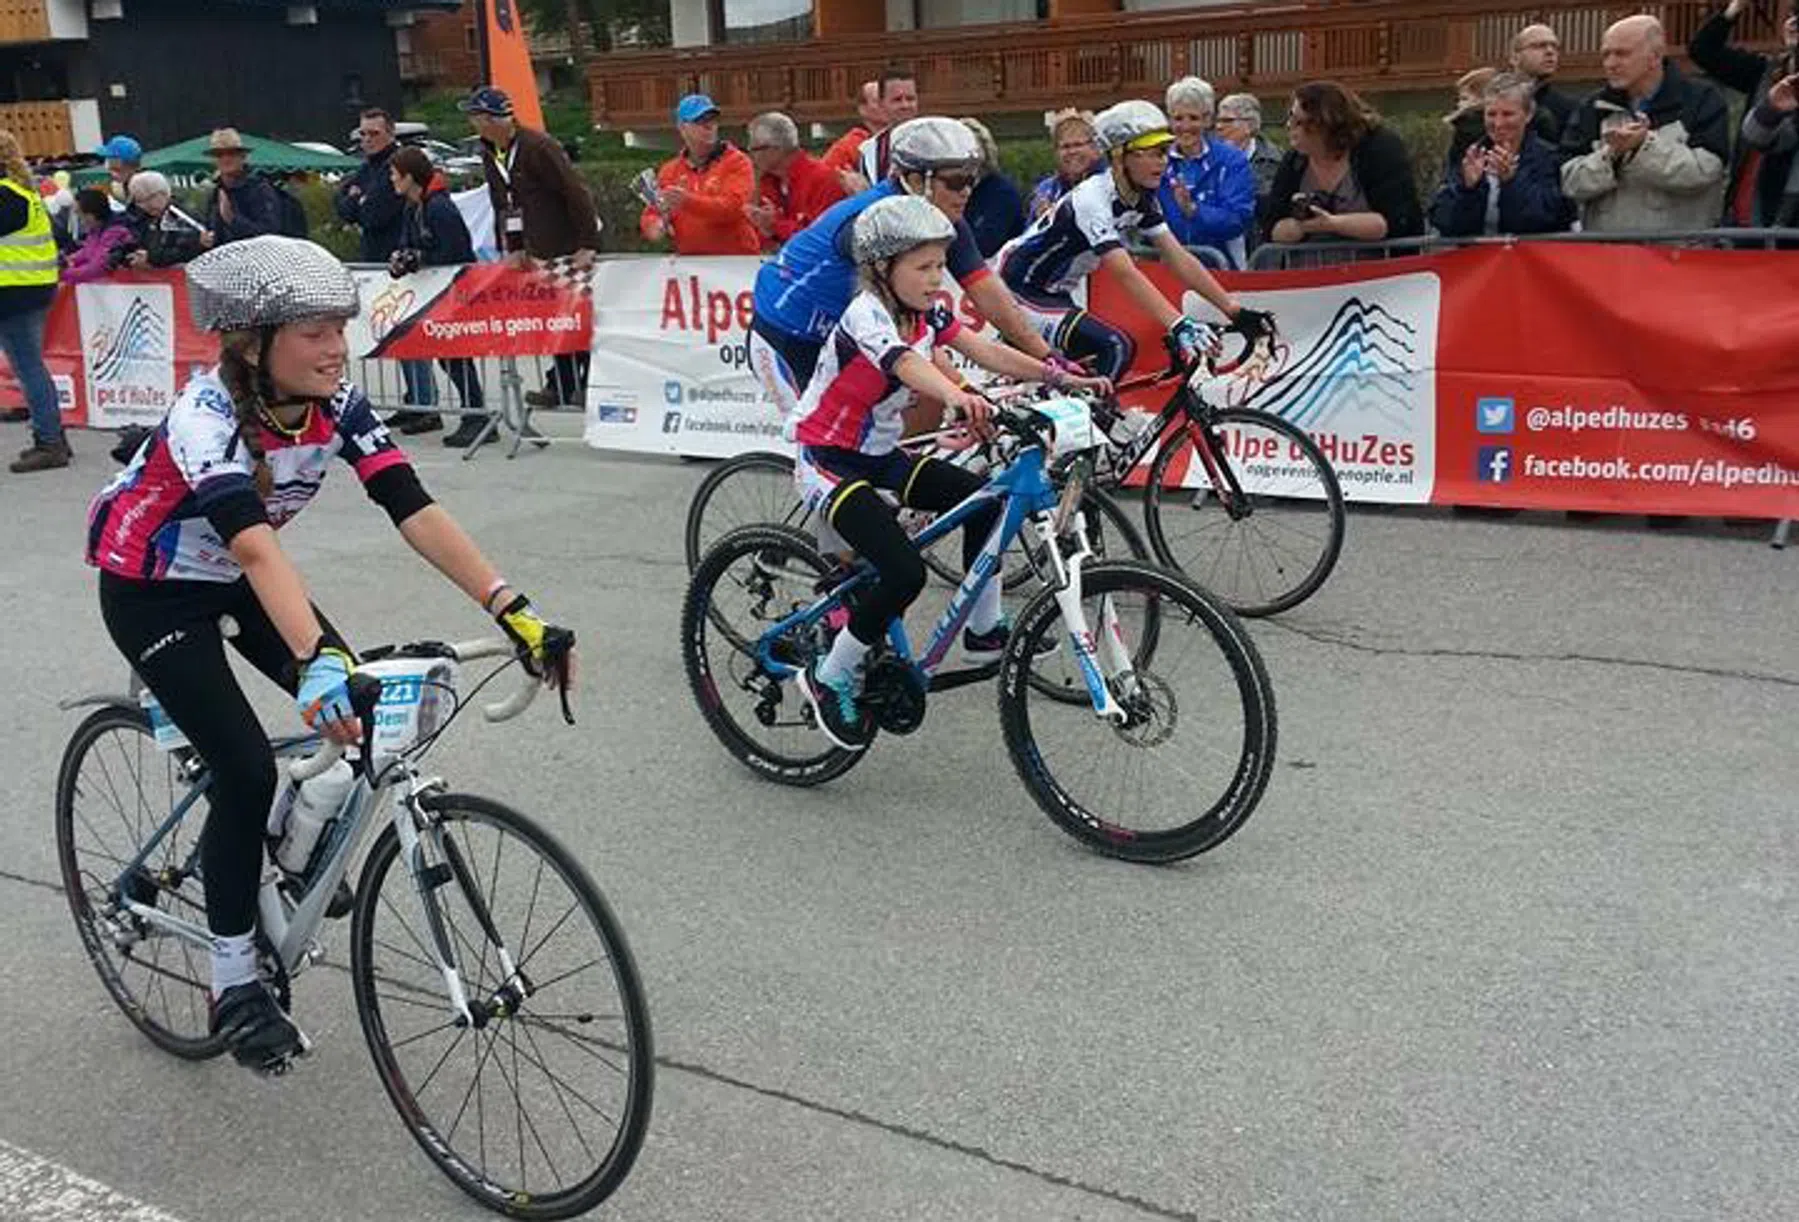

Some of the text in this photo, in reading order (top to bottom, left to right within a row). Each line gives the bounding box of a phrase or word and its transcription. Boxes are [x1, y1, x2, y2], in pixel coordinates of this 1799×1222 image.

[661, 275, 755, 344] Alpe
[422, 319, 488, 340] Opgeven
[490, 315, 503, 334] is
[505, 319, 544, 337] geen
[1526, 406, 1689, 433] @alpedhuzes
